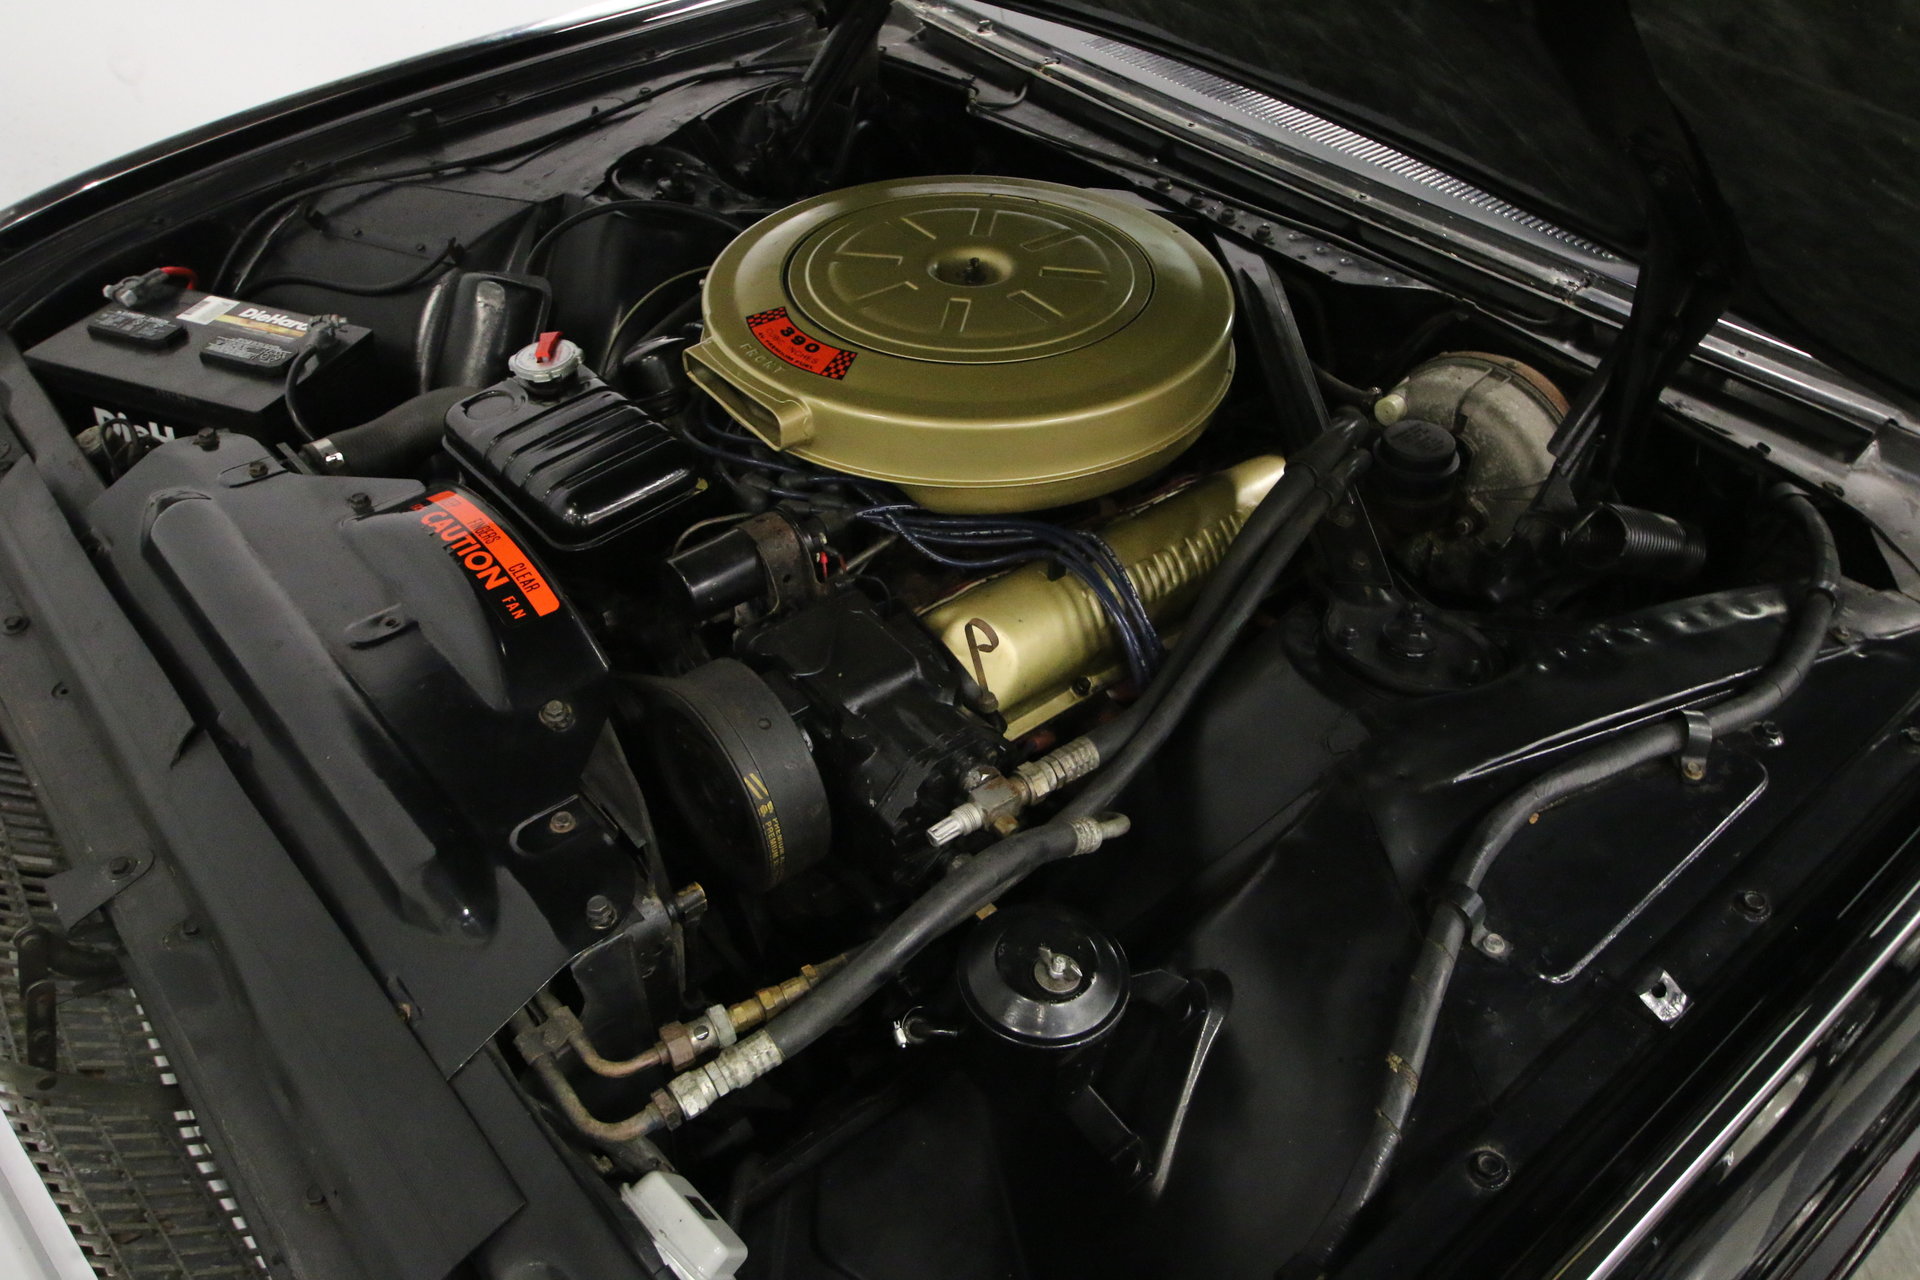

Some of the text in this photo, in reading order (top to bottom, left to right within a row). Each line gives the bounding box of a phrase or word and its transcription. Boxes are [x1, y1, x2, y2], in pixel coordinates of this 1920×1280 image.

[740, 344, 785, 373] FRONT
[780, 327, 820, 353] 390
[420, 511, 527, 619] CAUTION FAN
[467, 518, 541, 593] FINGERS CLEAR
